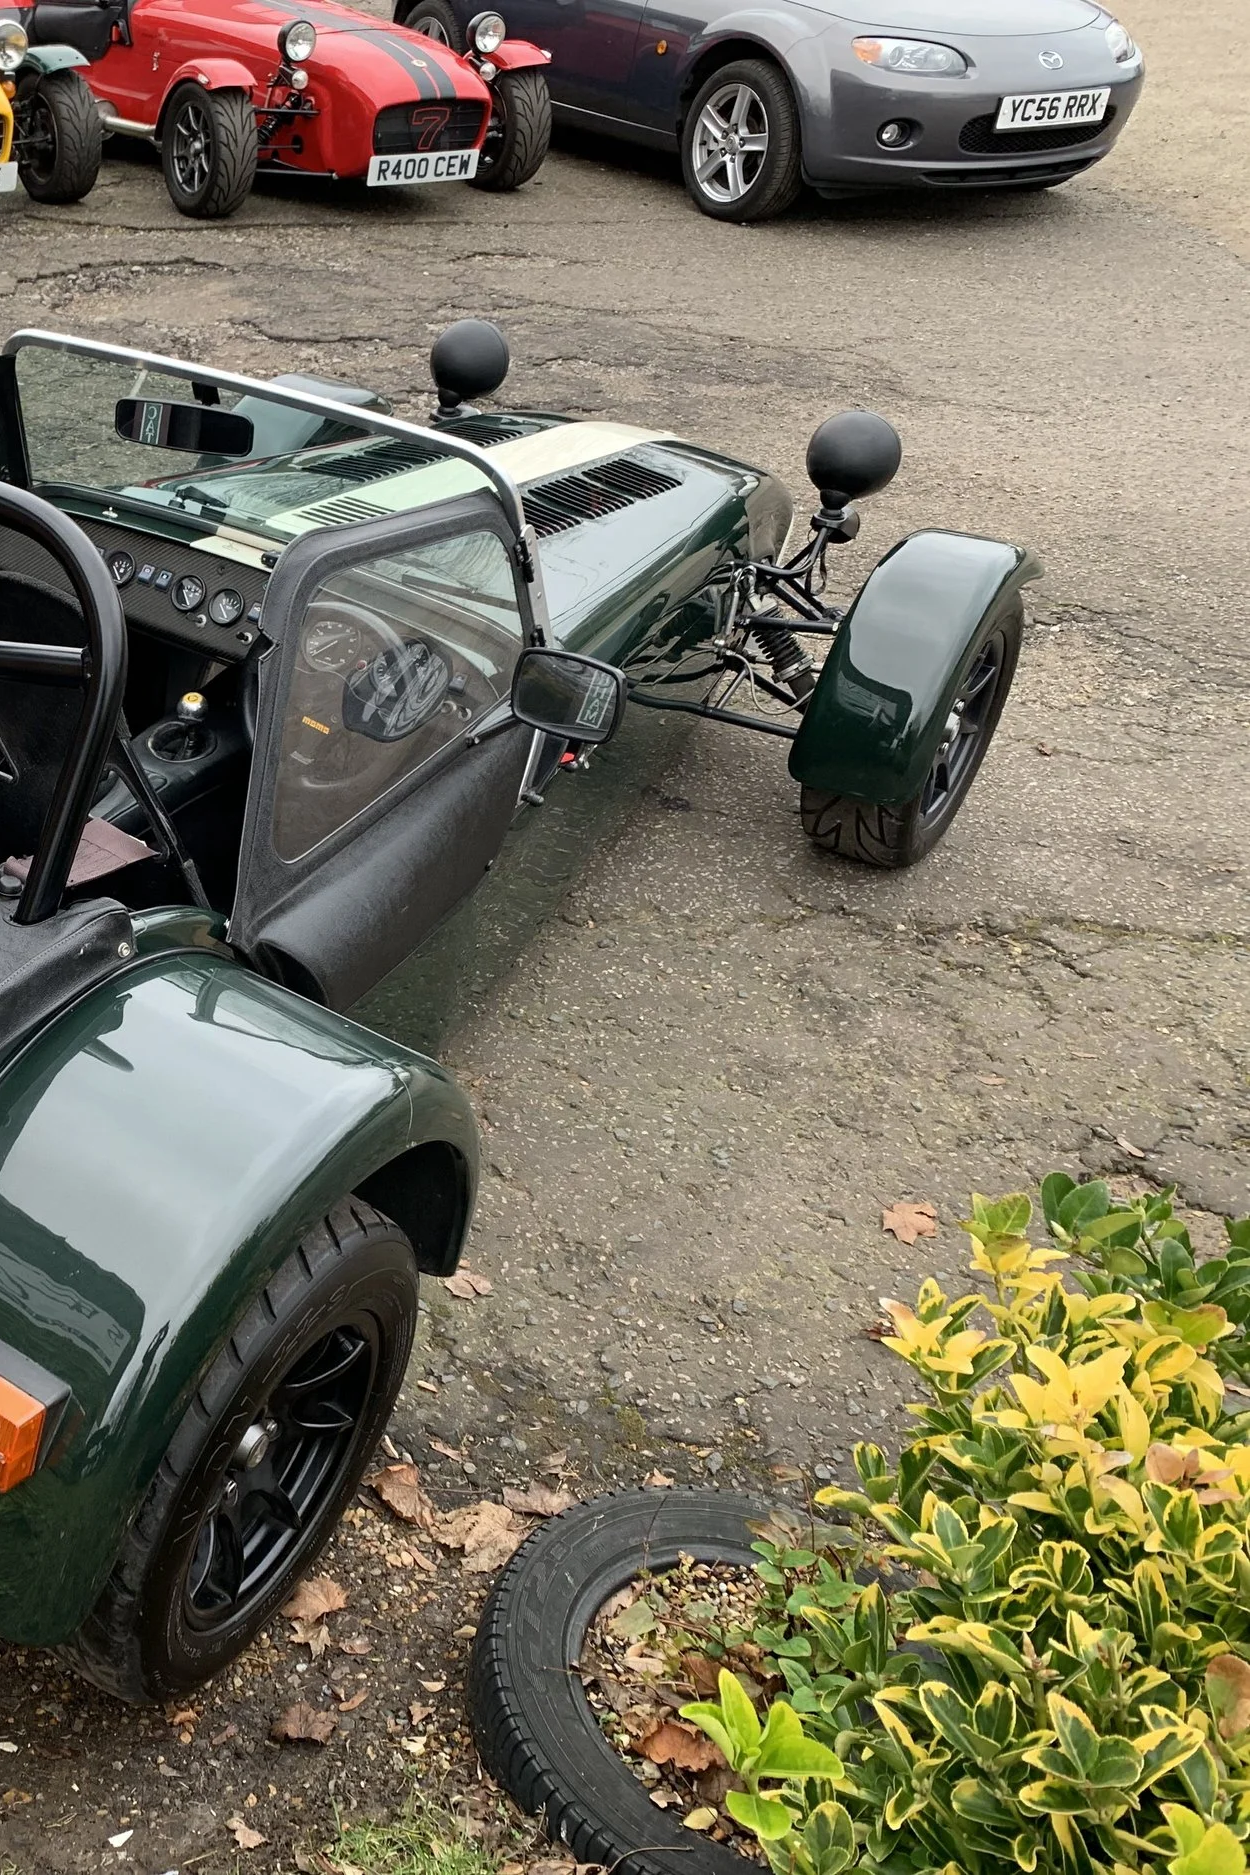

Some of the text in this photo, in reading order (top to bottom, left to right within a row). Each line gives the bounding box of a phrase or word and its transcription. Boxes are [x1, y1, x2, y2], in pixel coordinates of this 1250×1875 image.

[1010, 93, 1102, 122] YC56 RRX
[412, 106, 450, 150] 7
[377, 154, 472, 181] R400 CEW
